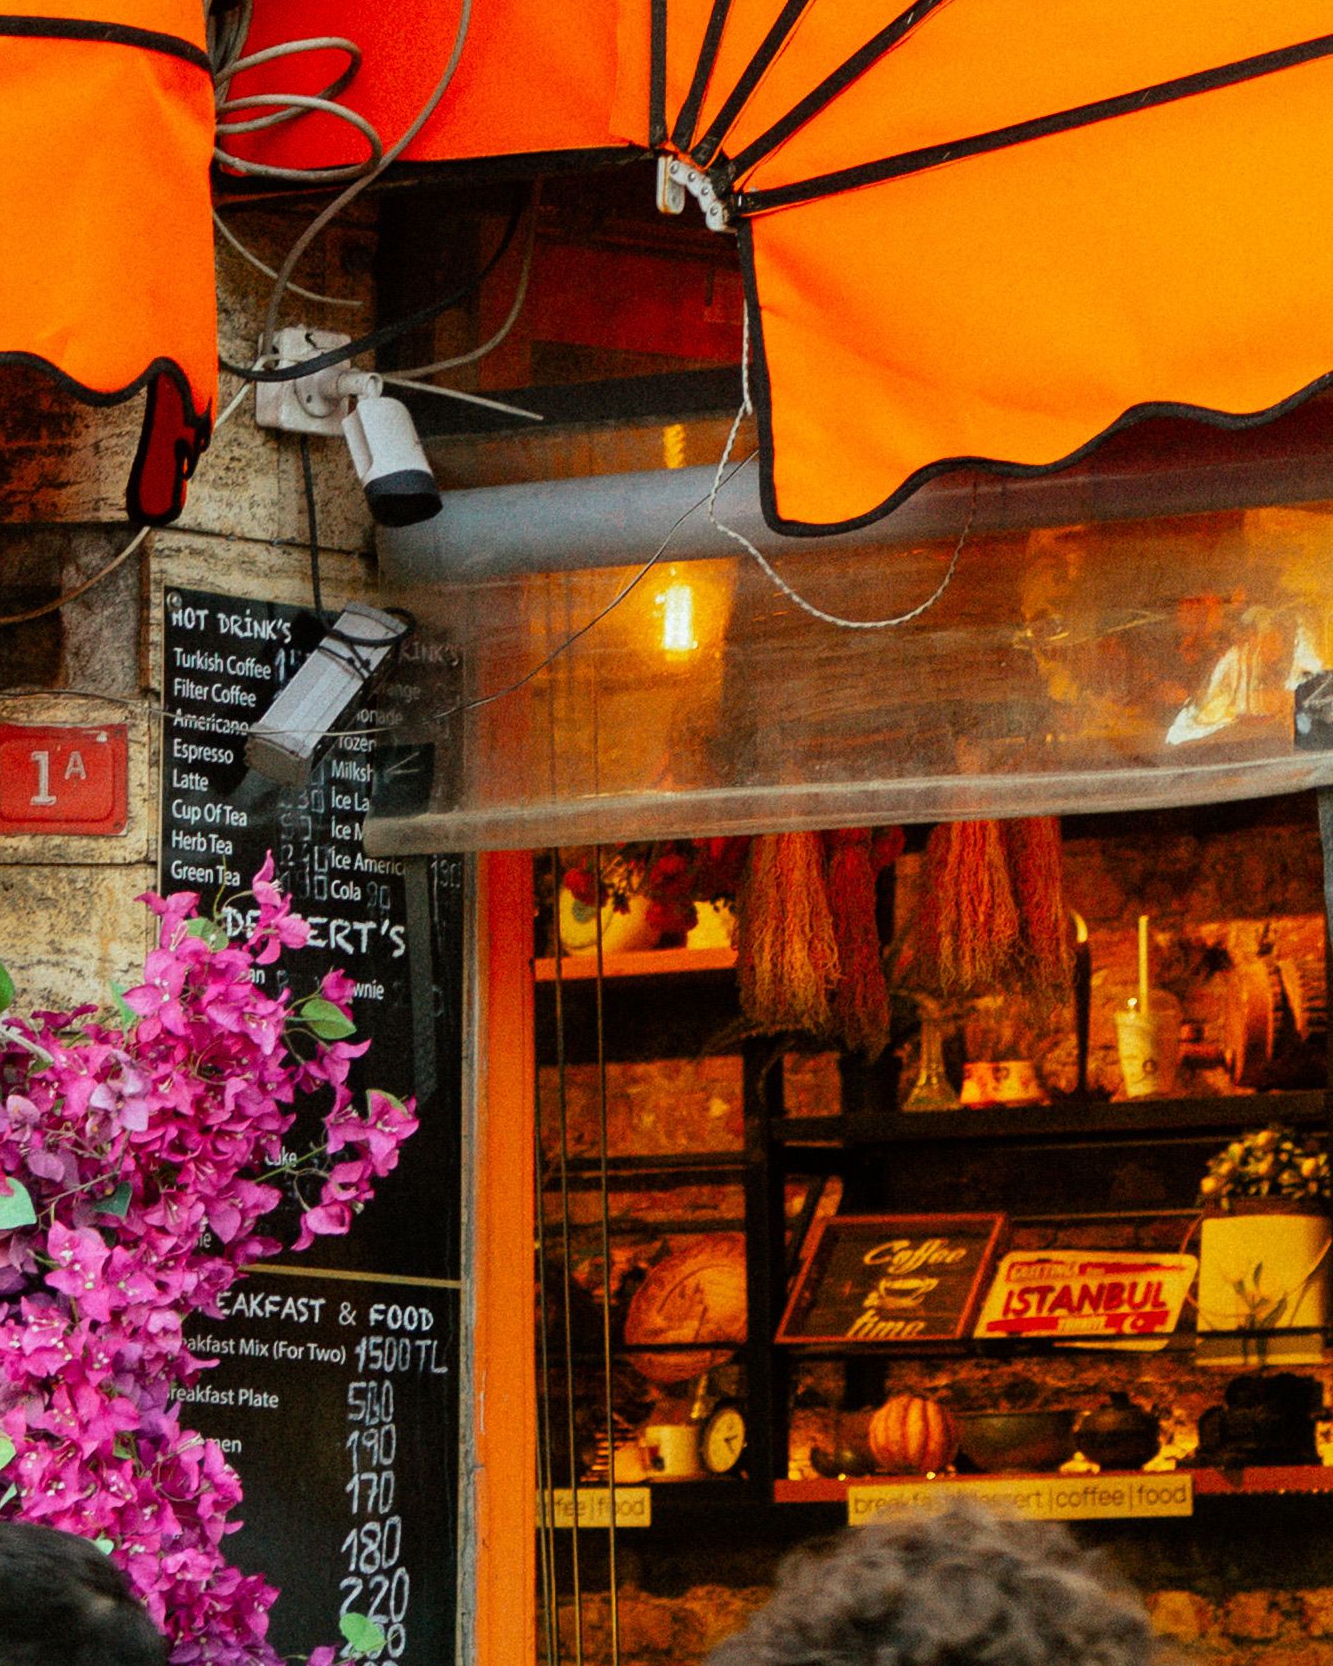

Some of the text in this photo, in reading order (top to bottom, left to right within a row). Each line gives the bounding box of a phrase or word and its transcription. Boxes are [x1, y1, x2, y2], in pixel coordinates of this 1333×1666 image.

[171, 606, 209, 631] HOT
[173, 647, 223, 673] Turkish
[226, 655, 271, 680] Coffee
[173, 678, 257, 708] Filter Coffee
[173, 708, 249, 736] Americano
[173, 738, 234, 765] Espresso
[172, 769, 209, 792] Latte
[171, 799, 247, 826] Cup Of Tea
[171, 830, 207, 852] Herb
[208, 834, 233, 855] Tea
[171, 860, 213, 884] Green
[215, 865, 240, 886] Tea
[330, 880, 362, 902] Cola
[863, 1238, 967, 1275] Coffee
[1002, 1281, 1167, 1317] ISTANBUL
[338, 1301, 357, 1326] &
[369, 1303, 433, 1331] FOOD
[239, 1337, 269, 1358] Mix
[273, 1339, 304, 1361] (For
[306, 1342, 347, 1365] Two)
[168, 1384, 235, 1407] reakfast
[238, 1388, 279, 1409] Plate
[345, 1423, 396, 1474] 190
[345, 1470, 395, 1515] 170
[1056, 1486, 1124, 1508] coffee
[1135, 1484, 1187, 1505] food
[340, 1515, 402, 1574] 180
[339, 1567, 410, 1624] 220
